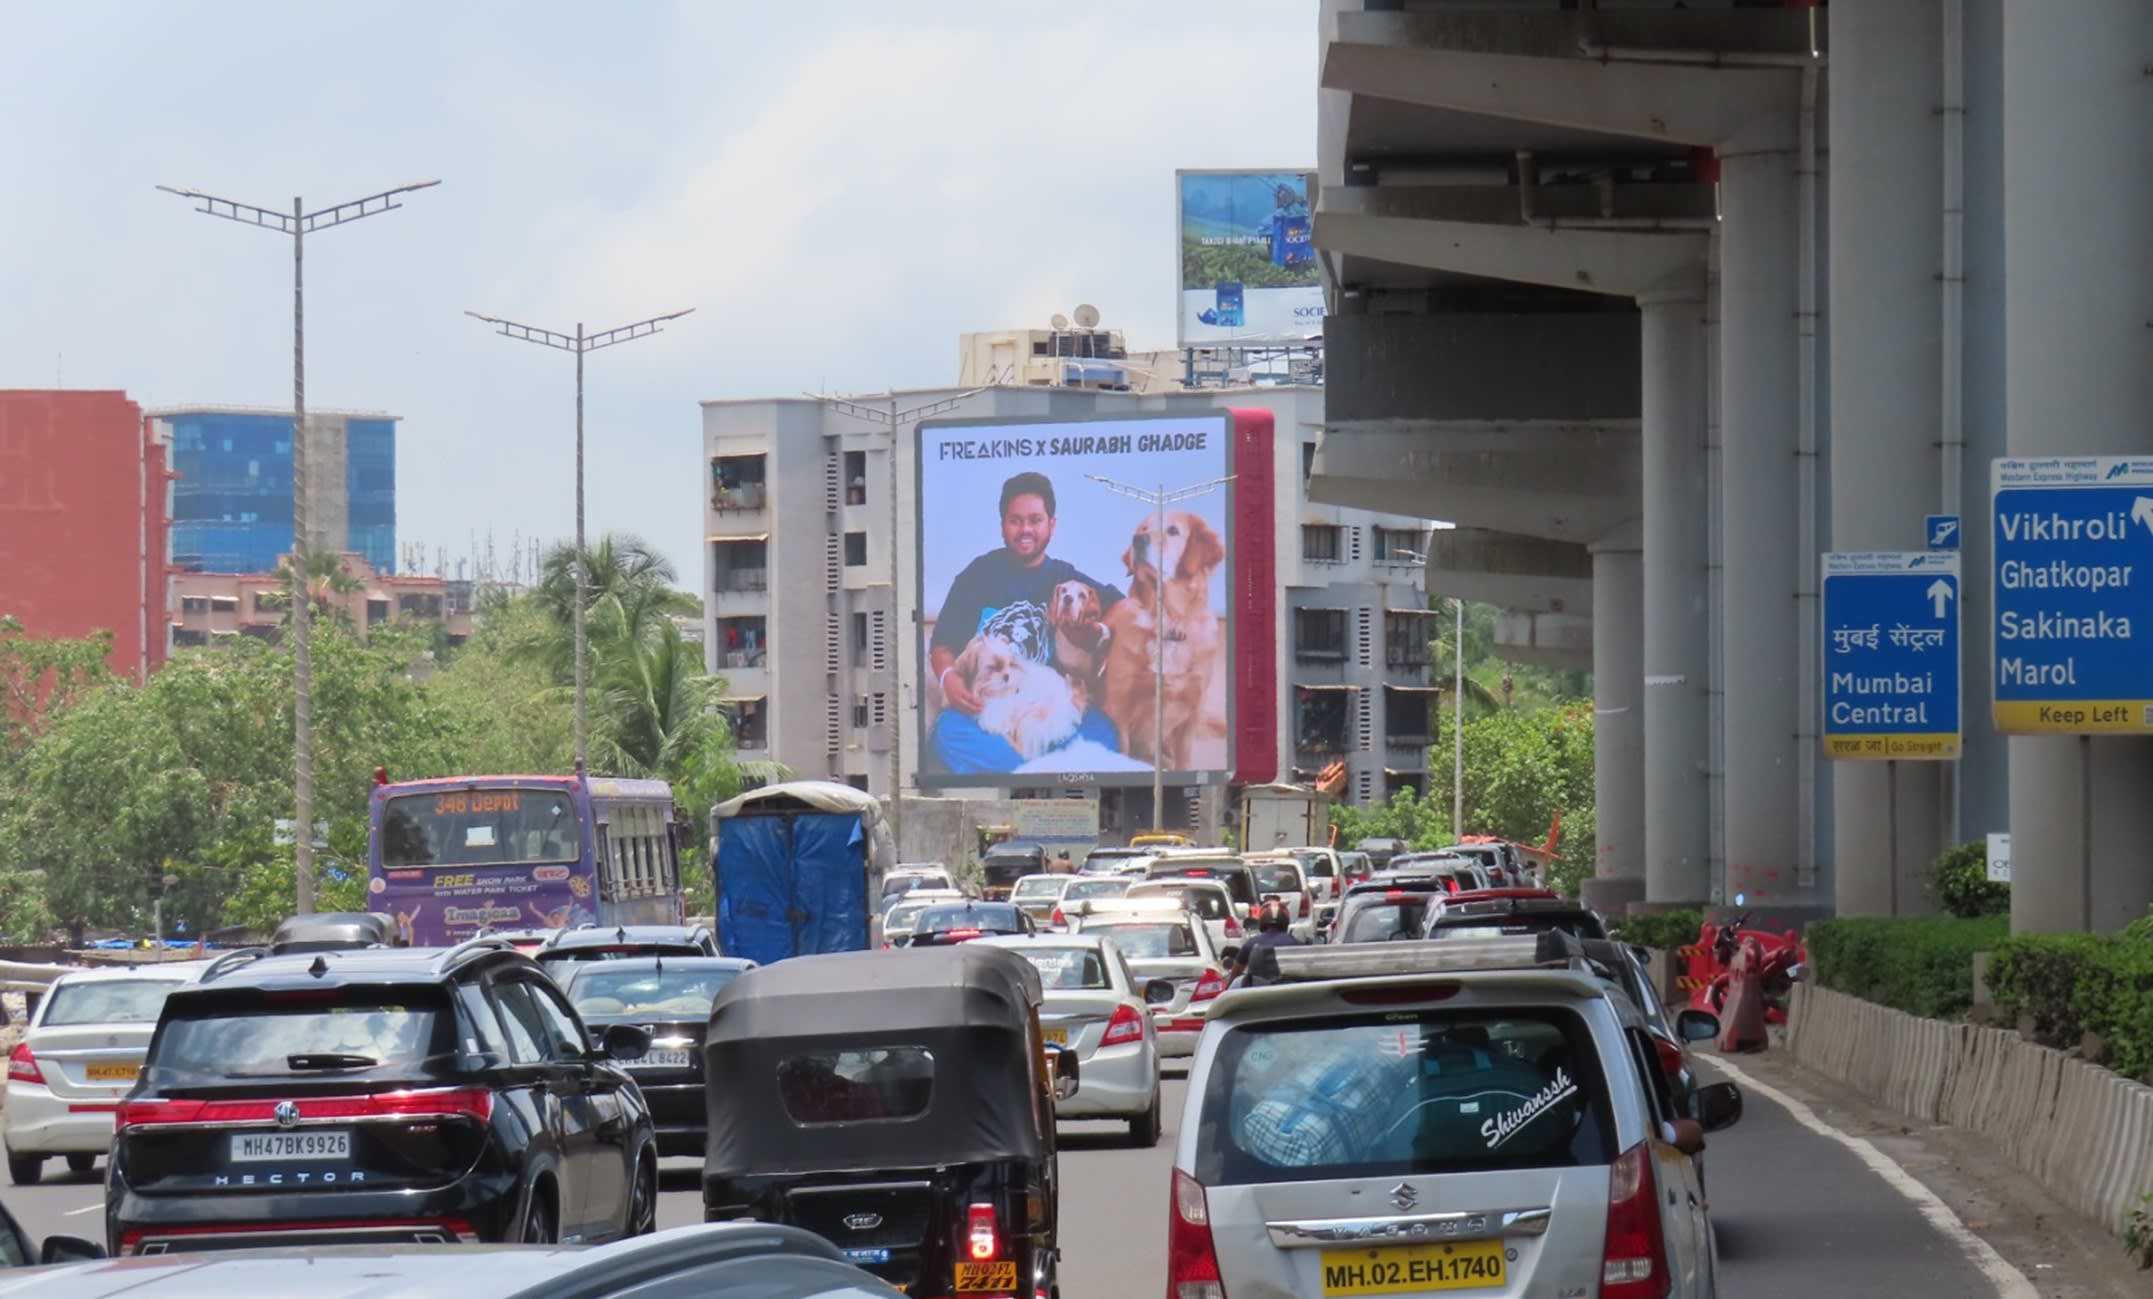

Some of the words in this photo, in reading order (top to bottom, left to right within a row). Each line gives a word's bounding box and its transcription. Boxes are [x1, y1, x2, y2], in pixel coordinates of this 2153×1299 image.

[1293, 306, 1325, 317] SOCIE
[940, 439, 1033, 461] FREAKINS
[1050, 435, 1132, 456] SAURABH
[1138, 432, 1208, 452] GHADGE
[2000, 512, 2126, 541] Vikhroli
[2001, 560, 2132, 592] Ghatkopar
[1832, 623, 1880, 653] मुंबई
[1888, 622, 1945, 652] सेंट्रल
[2001, 610, 2131, 640] Sakinaka
[1832, 672, 1932, 694] Mumbai
[2001, 657, 2076, 685] Marol
[1832, 702, 1928, 724] Central
[2040, 707, 2085, 725] Keep
[2092, 705, 2128, 722] Left
[434, 874, 475, 888] FREE
[504, 875, 528, 884] PARK
[453, 887, 483, 896] WATER
[484, 886, 506, 895] PARK
[508, 884, 539, 893] TICKET
[1481, 1066, 1573, 1148] Shivanssh
[243, 1136, 347, 1156] MH47BK9926
[215, 1171, 365, 1185] HECTOR
[1326, 1255, 1500, 1288] MH.02.EH.1740
